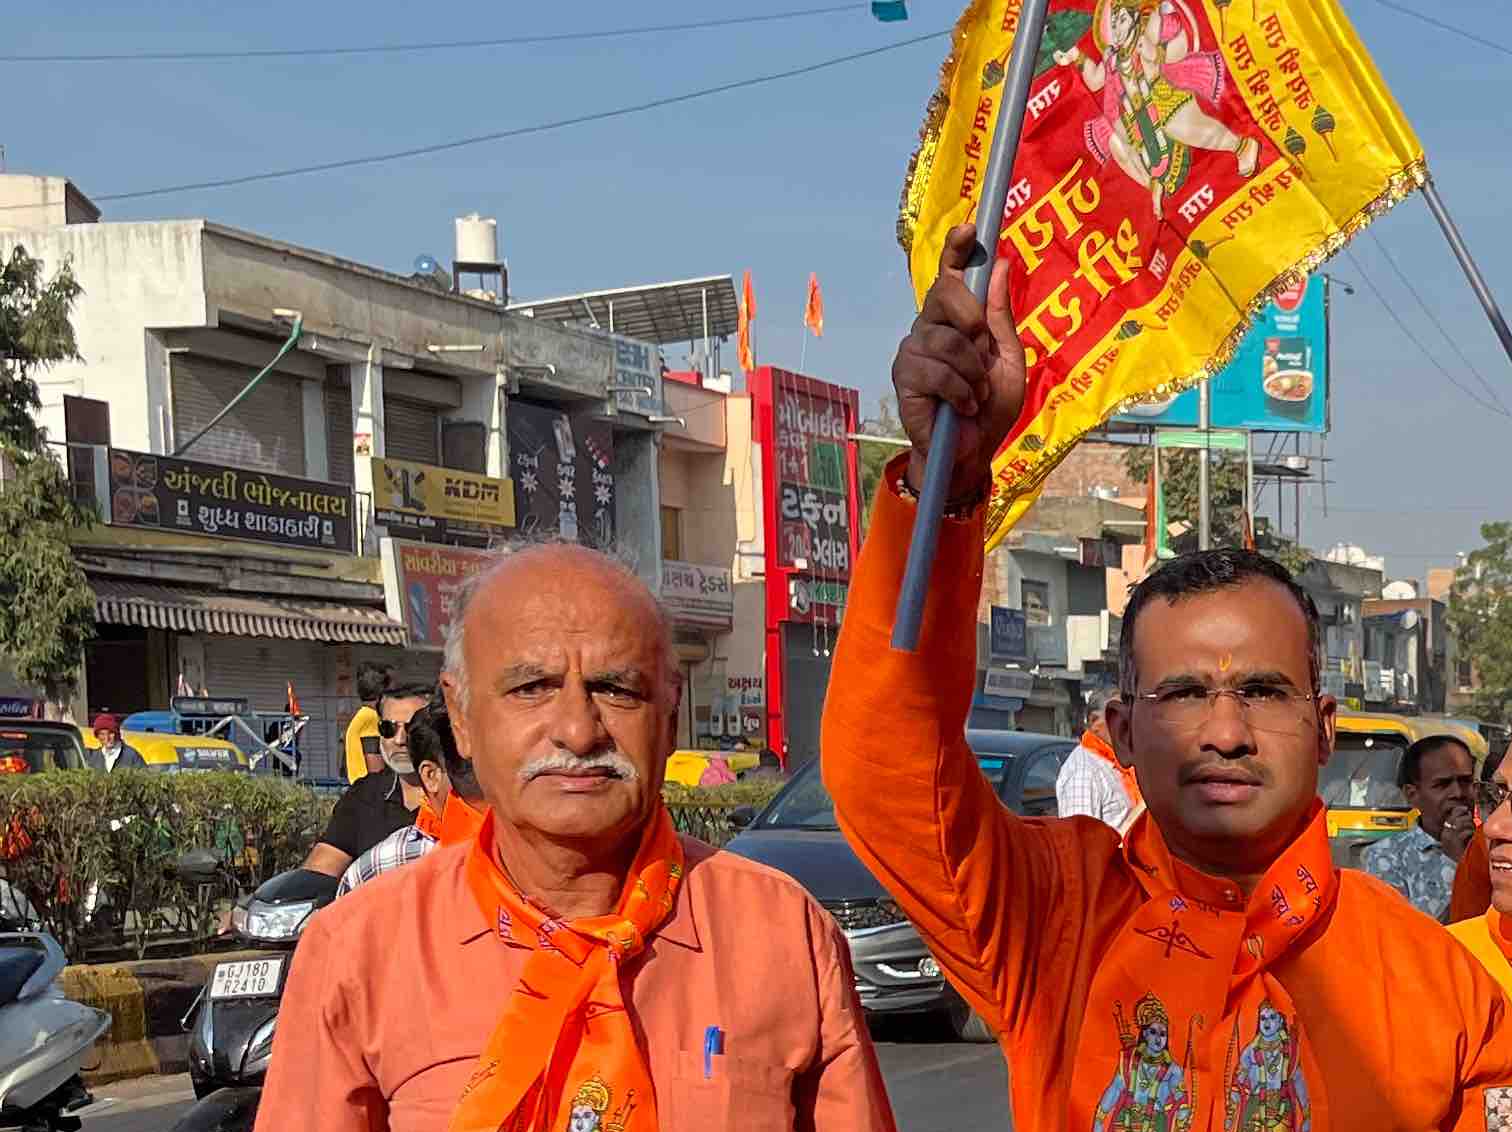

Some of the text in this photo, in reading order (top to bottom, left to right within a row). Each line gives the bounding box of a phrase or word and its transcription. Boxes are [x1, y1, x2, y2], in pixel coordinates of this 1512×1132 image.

[164, 466, 237, 500] અંજલી
[444, 478, 499, 502] KDM
[226, 962, 269, 978] GJ18D
